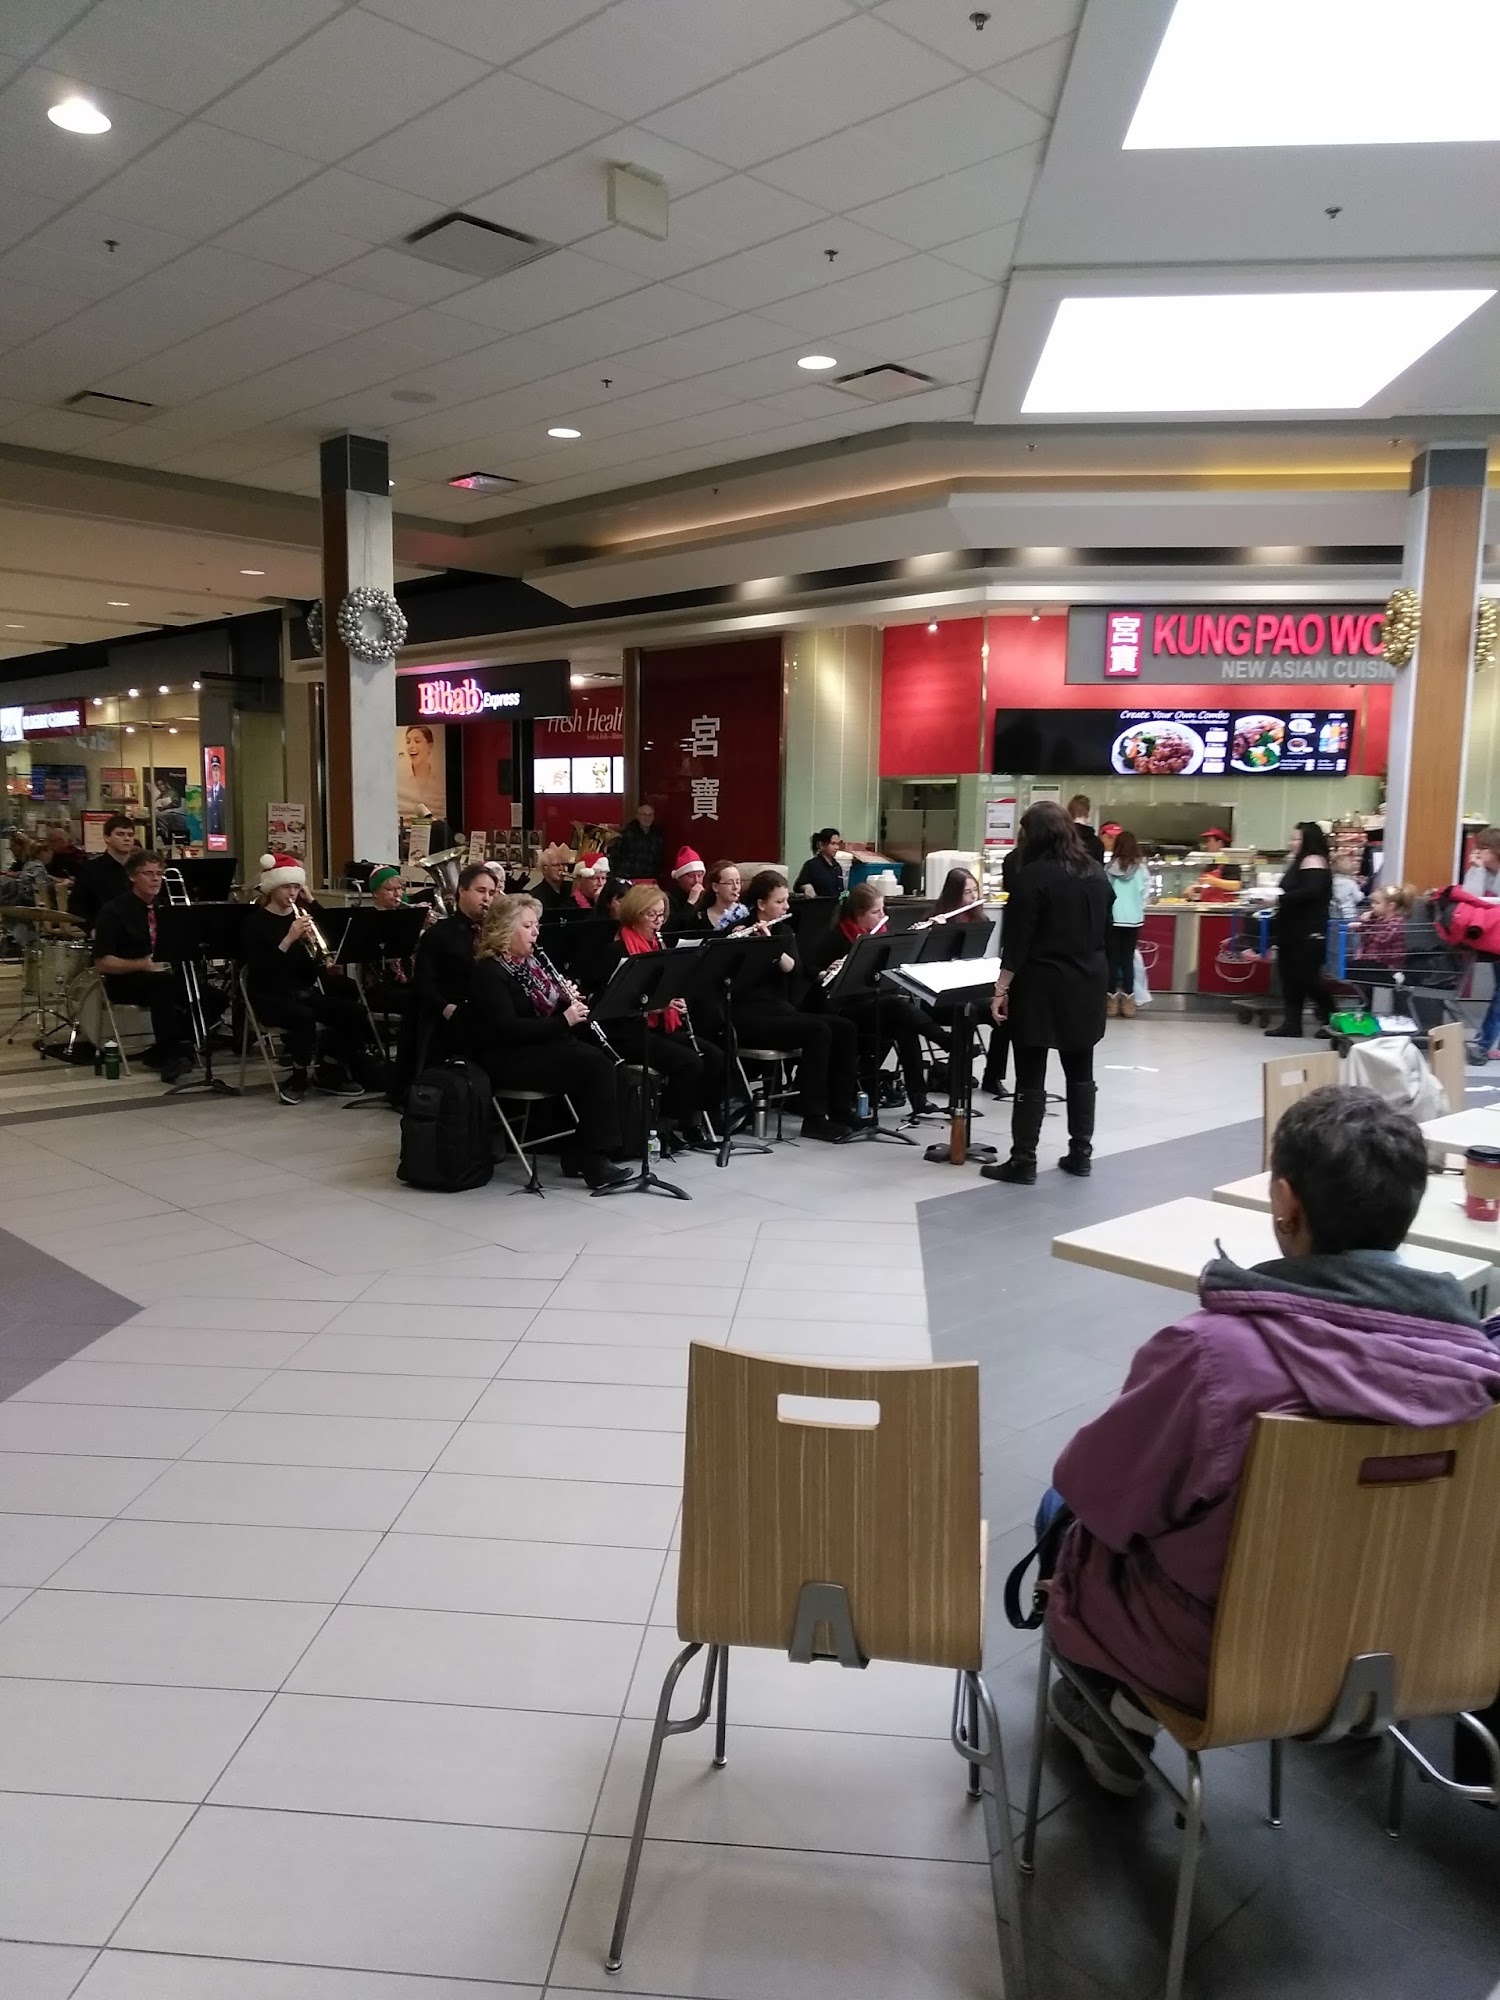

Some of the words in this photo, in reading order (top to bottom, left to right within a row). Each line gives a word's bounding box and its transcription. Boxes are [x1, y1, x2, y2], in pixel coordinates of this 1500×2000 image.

[1152, 613, 1251, 656] KUNG
[1254, 613, 1326, 656] PAO
[1221, 660, 1264, 679] NEW
[1268, 660, 1328, 680] ASIAN
[418, 679, 483, 715] Bibab
[483, 692, 521, 711] Express
[1119, 710, 1151, 720] Create
[1152, 710, 1175, 720] Your
[1197, 710, 1231, 720] Combo
